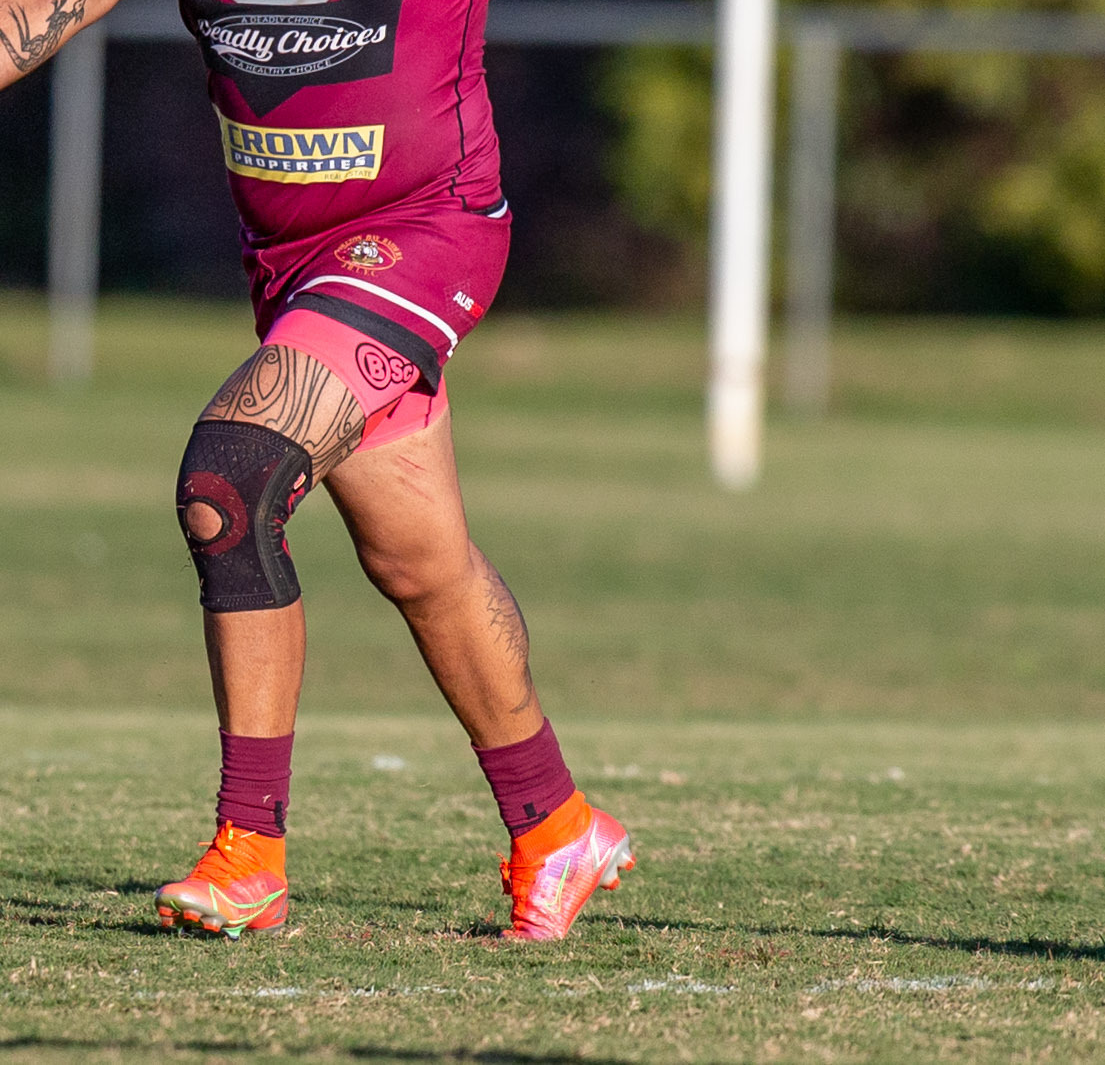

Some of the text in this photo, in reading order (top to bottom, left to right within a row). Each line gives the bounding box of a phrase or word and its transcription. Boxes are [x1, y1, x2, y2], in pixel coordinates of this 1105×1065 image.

[241, 16, 248, 24] A
[250, 16, 285, 24] DEADLY
[198, 18, 387, 62] Deadly Choices
[227, 123, 376, 157] CROWN
[234, 151, 367, 172] PROPERTIES
